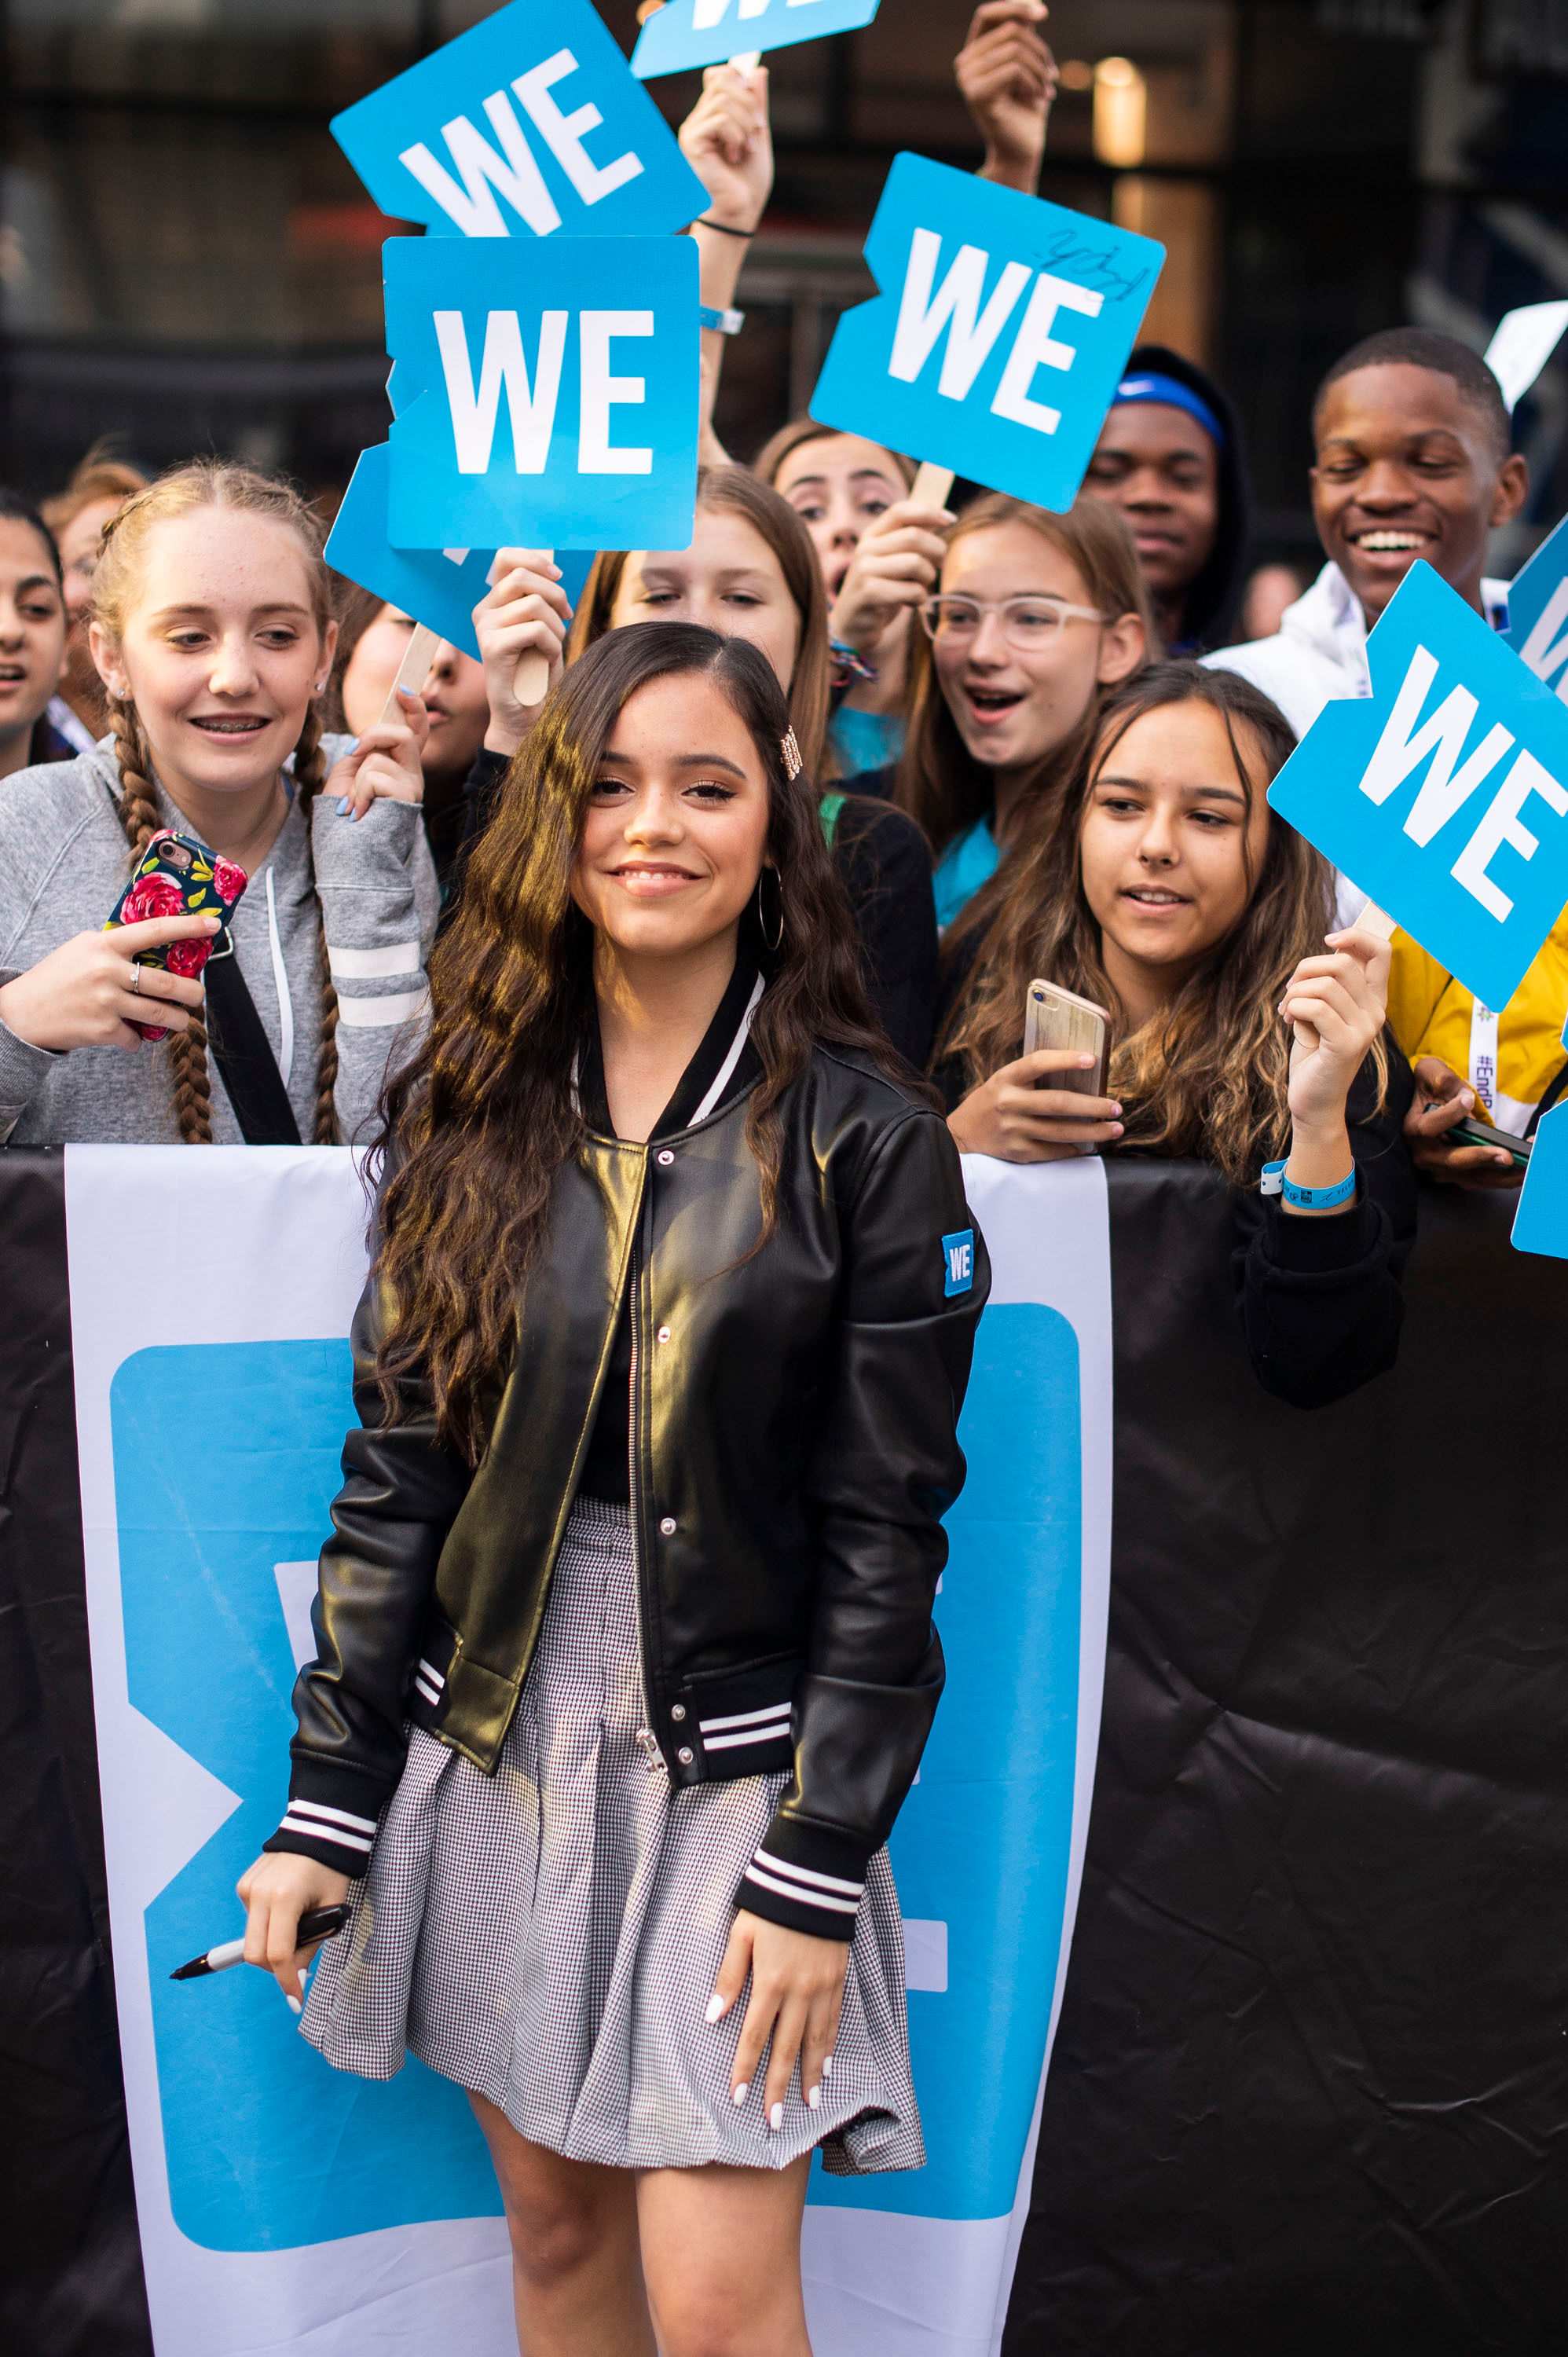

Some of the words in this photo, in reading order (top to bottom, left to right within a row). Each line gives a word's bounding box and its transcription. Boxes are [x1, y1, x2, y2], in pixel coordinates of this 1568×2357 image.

[400, 49, 643, 236] WE
[434, 310, 654, 475] WE
[889, 228, 1104, 434] WE
[1359, 644, 1568, 924] WE
[949, 1244, 971, 1282] WE
